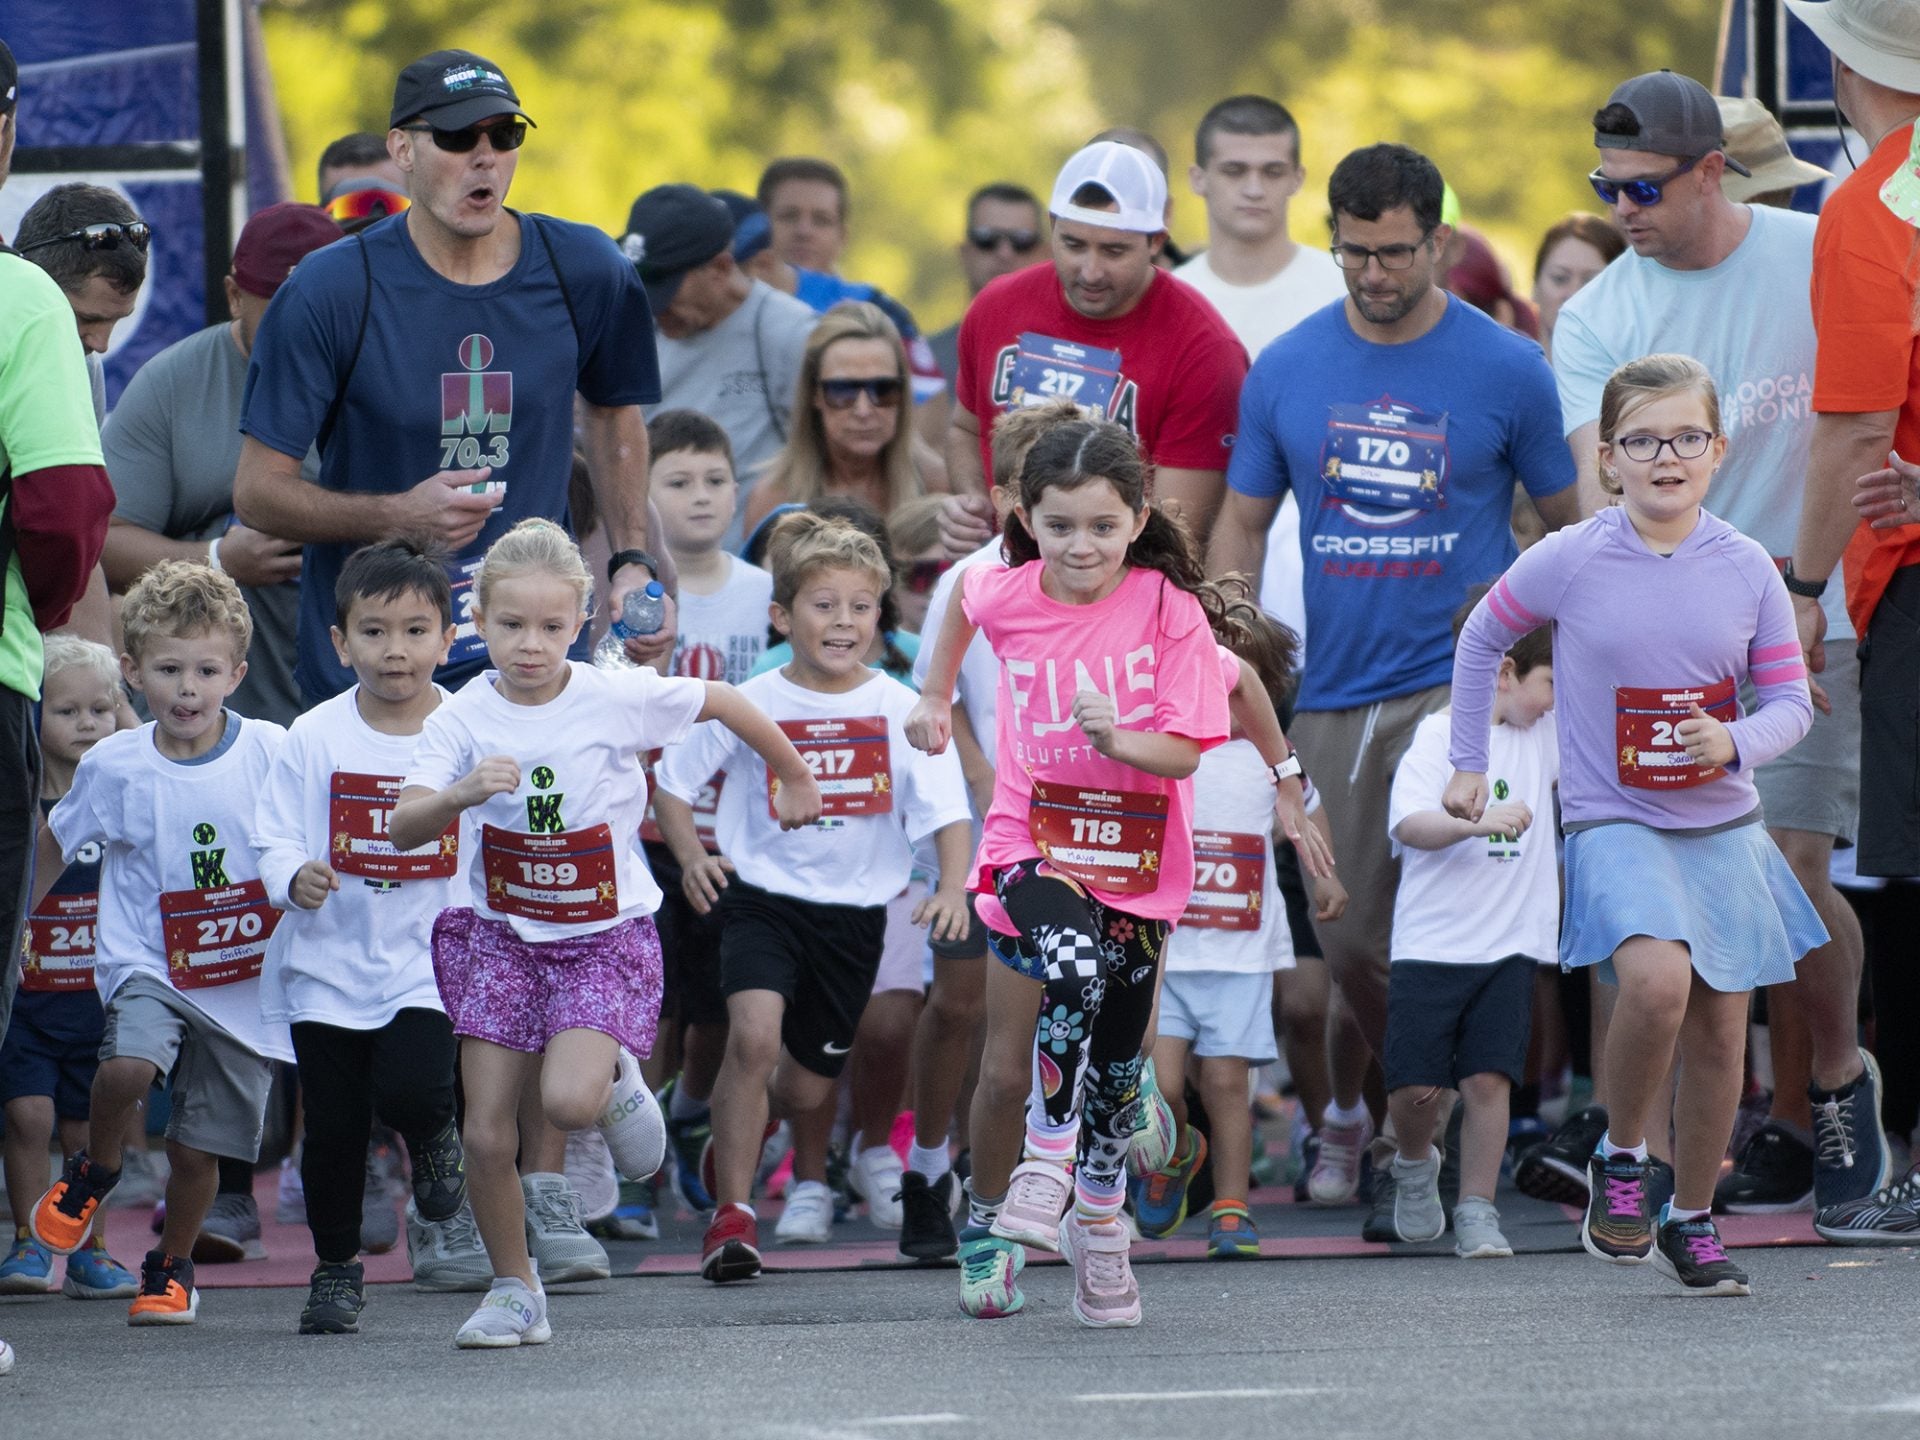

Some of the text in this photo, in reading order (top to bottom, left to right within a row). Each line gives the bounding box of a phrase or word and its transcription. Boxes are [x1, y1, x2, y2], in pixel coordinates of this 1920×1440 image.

[447, 80, 472, 92] 70.3
[1039, 369, 1085, 397] 217
[440, 435, 509, 468] 70.3
[1357, 437, 1410, 465] 170
[1312, 533, 1460, 555] CROSSFIT
[1323, 560, 1441, 577] AUGUSTA
[729, 635, 759, 652] RUN
[802, 749, 855, 775] 217
[1017, 741, 1108, 764] BLUFFT
[1070, 818, 1122, 845] 118
[518, 861, 578, 885] 189
[1197, 861, 1237, 888] 70
[204, 887, 246, 901] IRONKIDS
[521, 906, 535, 914] THIS
[197, 912, 262, 946] 270
[220, 947, 254, 961] Griffin
[228, 969, 239, 977] MY
